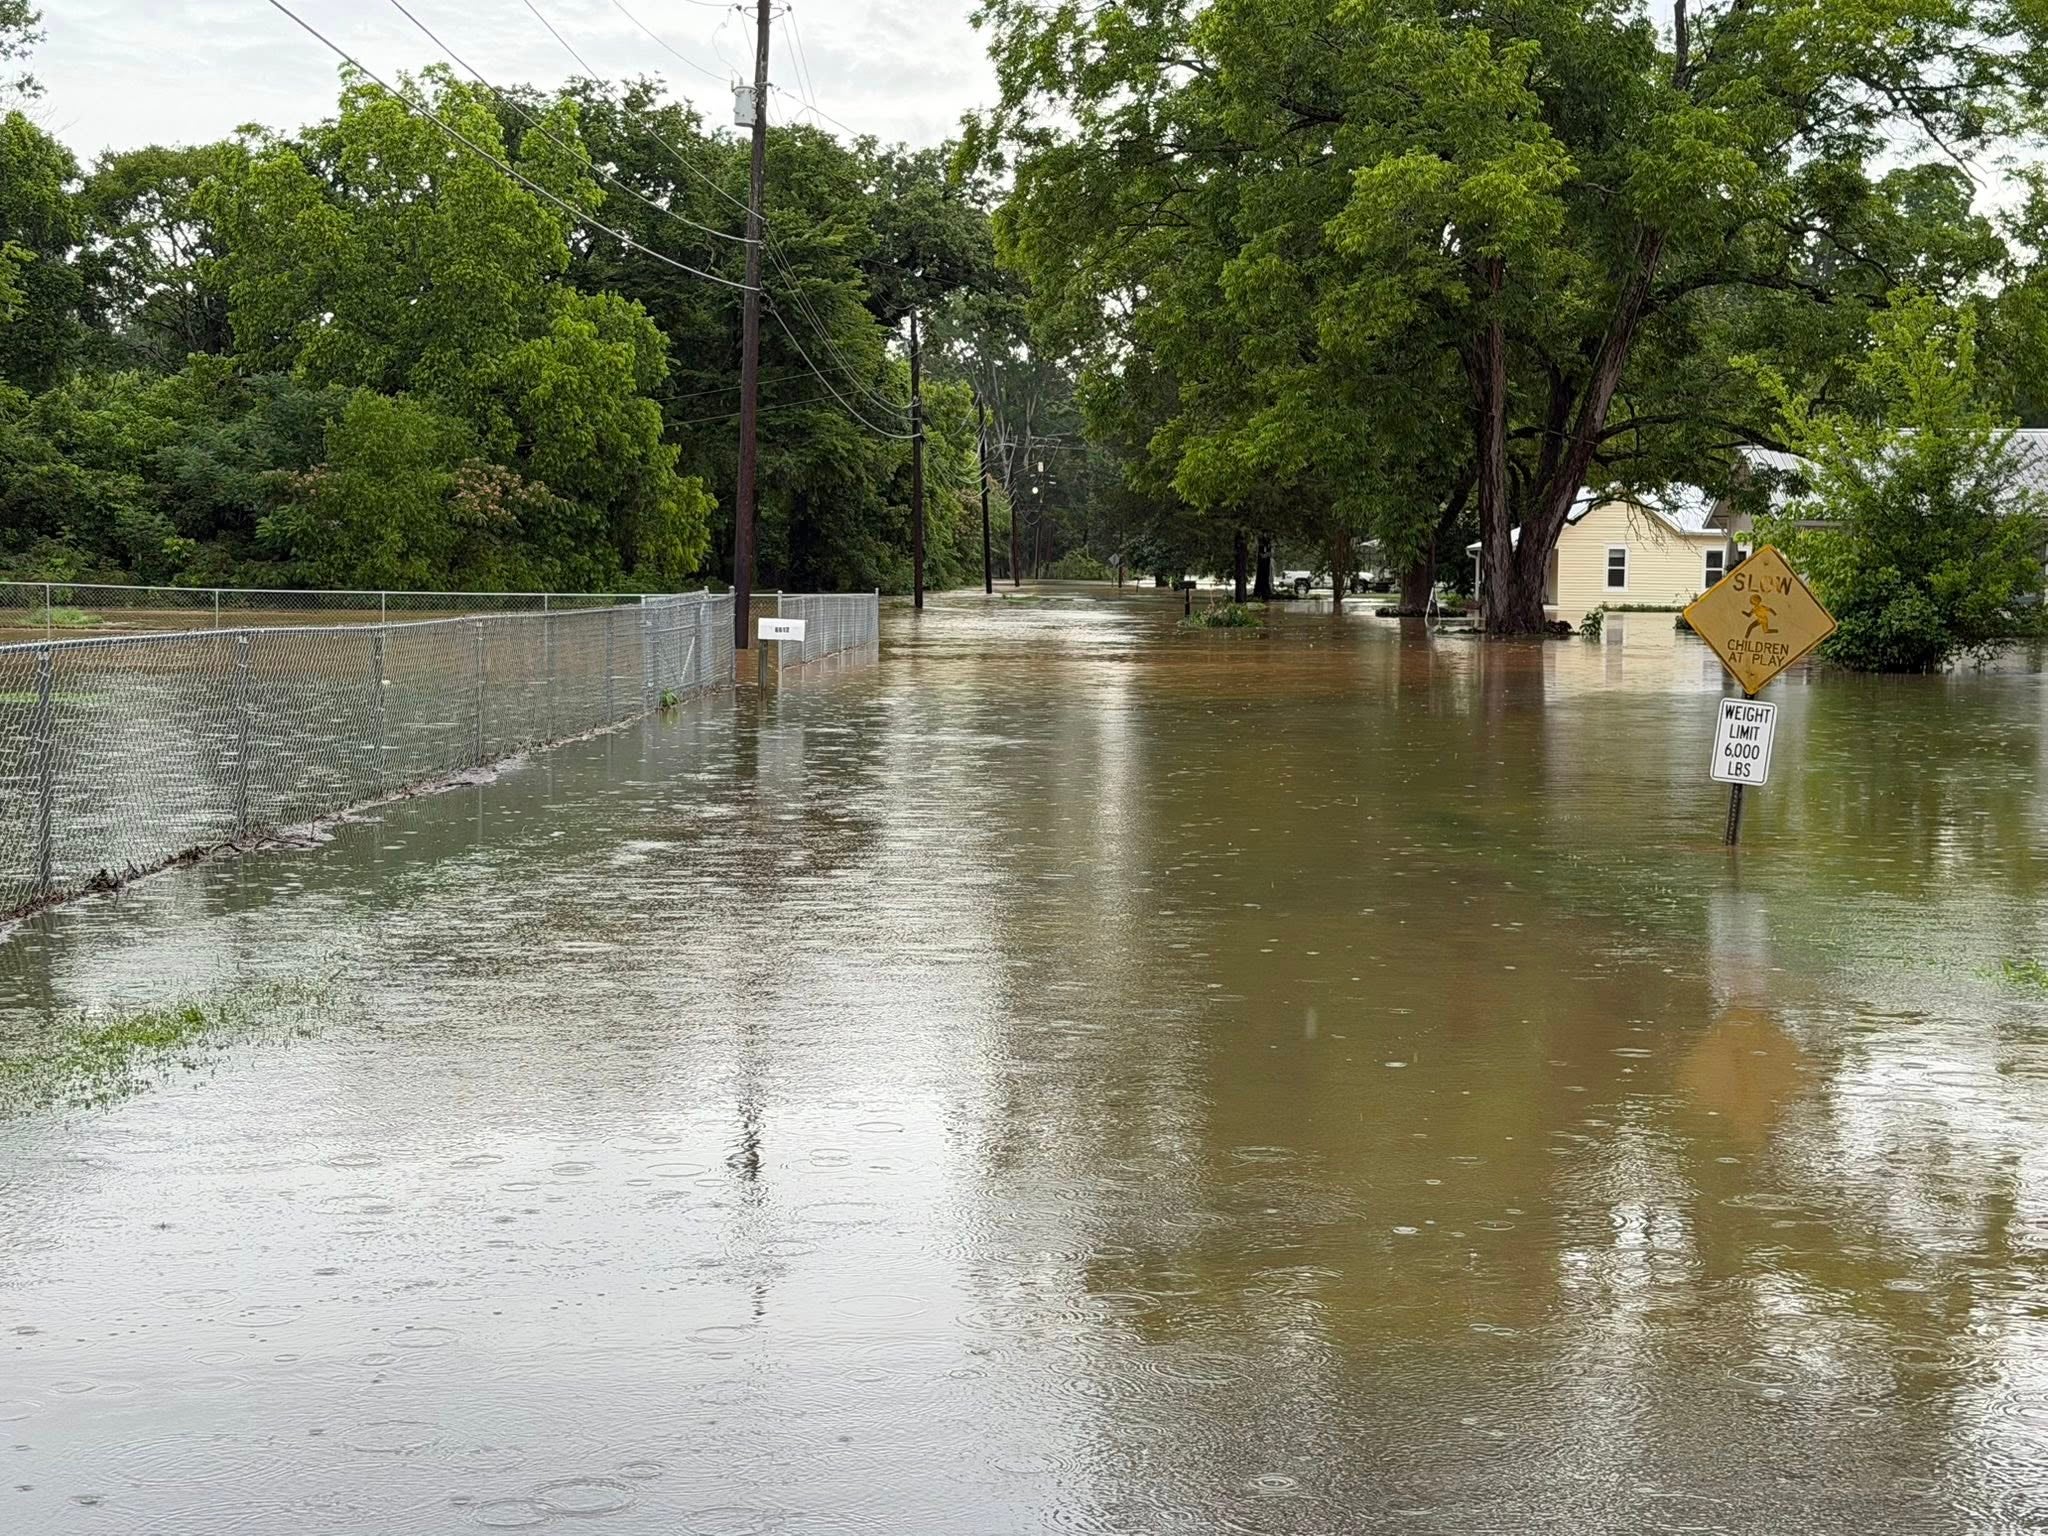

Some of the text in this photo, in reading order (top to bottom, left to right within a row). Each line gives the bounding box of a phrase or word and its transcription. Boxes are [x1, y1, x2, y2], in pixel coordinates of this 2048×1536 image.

[1727, 638, 1790, 657] CHILDREN
[1728, 651, 1785, 667] AT PLAY
[1725, 703, 1771, 724] WEIGHT
[1729, 723, 1761, 741] LIMIT
[1724, 742, 1760, 760] 6,000
[1727, 760, 1752, 778] LBS
